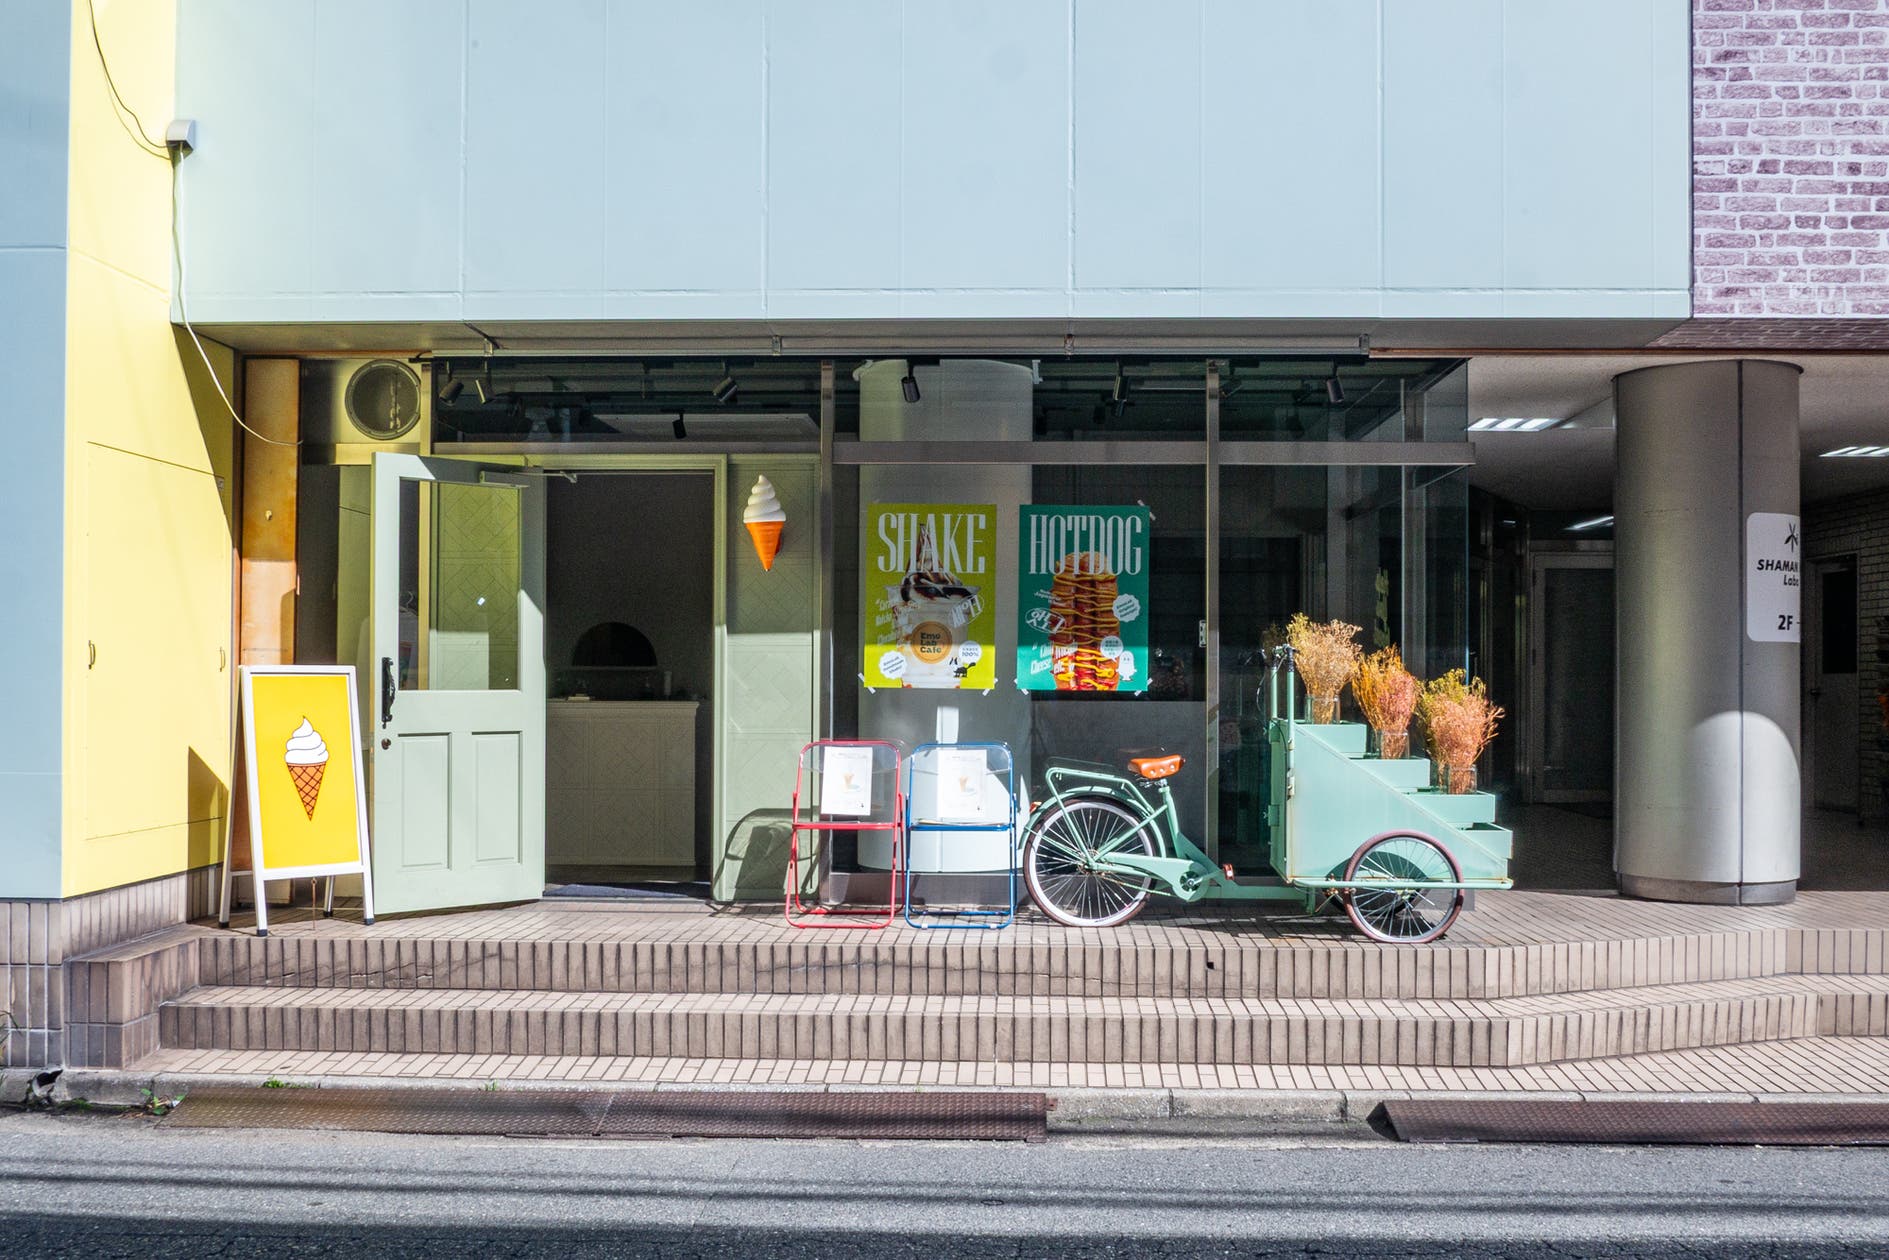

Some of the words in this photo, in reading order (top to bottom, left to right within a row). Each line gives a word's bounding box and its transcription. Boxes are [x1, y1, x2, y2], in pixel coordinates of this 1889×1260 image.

[877, 512, 986, 574] SHAKE
[1028, 514, 1142, 576] HOTDOG
[1778, 615, 1793, 631] 2F
[920, 632, 941, 640] Emo
[920, 639, 937, 647] Lab
